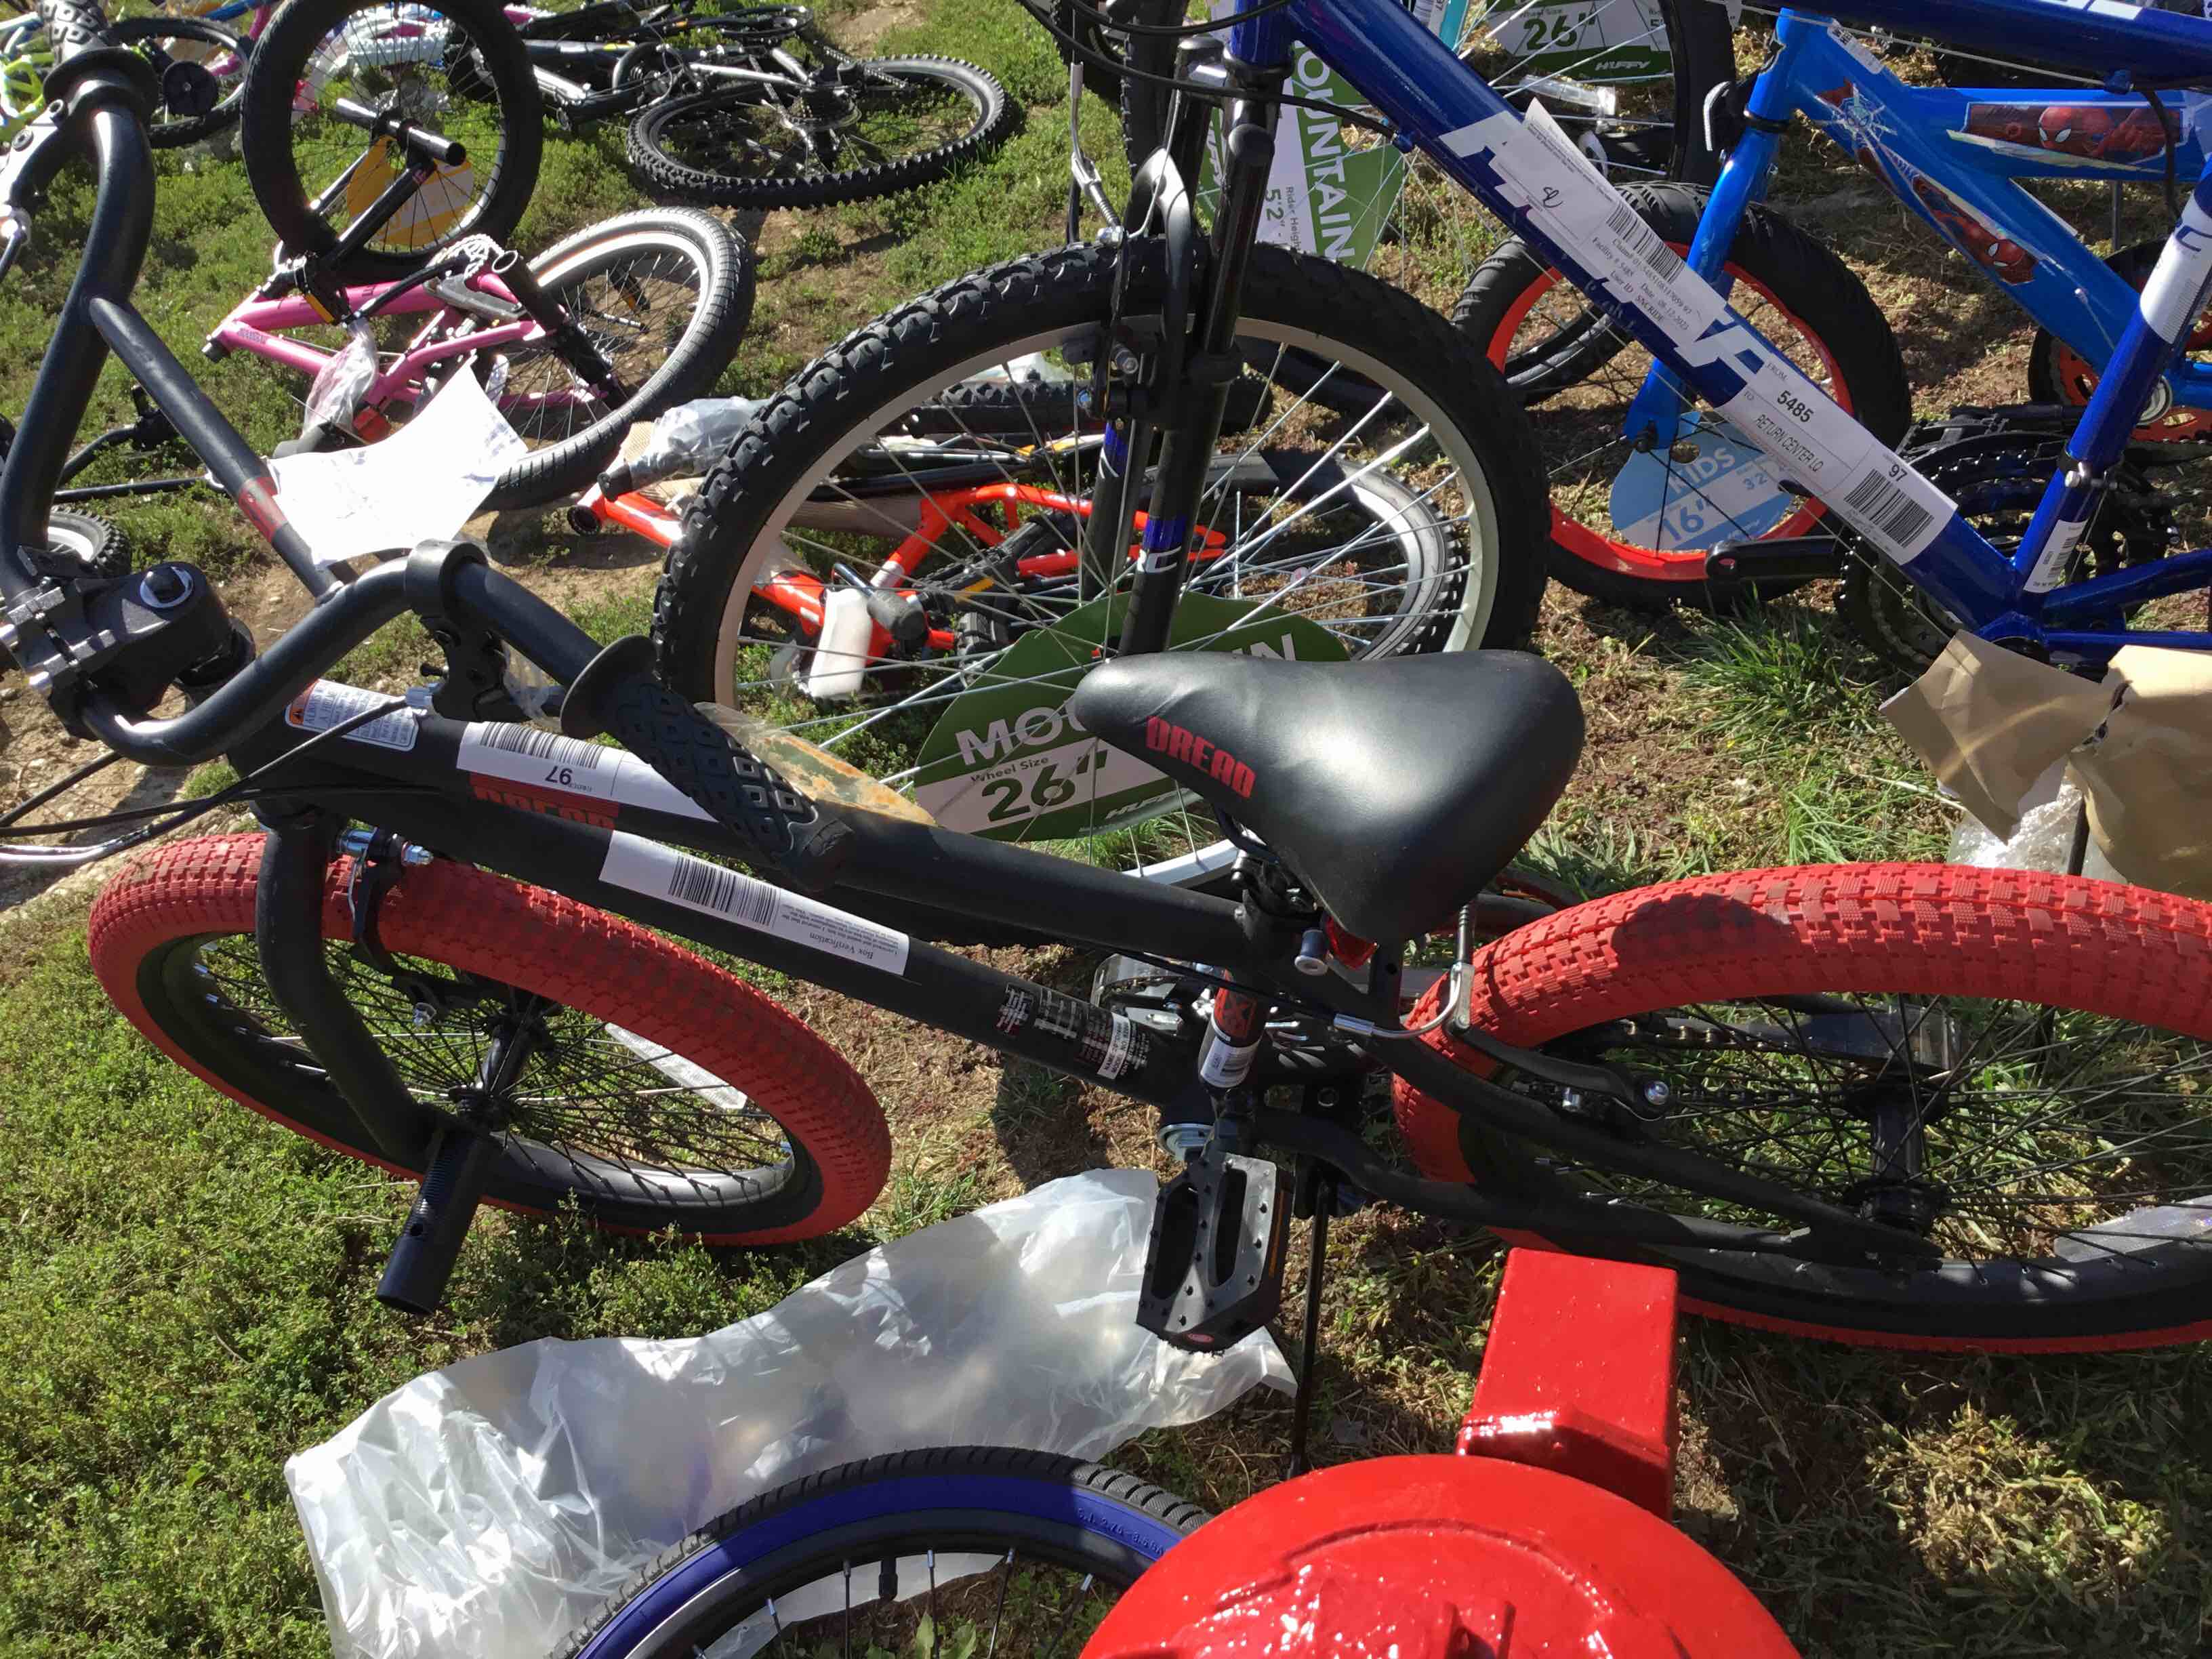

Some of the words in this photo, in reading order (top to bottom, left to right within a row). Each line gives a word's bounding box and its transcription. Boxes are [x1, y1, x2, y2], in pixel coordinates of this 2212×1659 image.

[1523, 12, 1596, 50] 26"
[1595, 60, 1651, 70] HUFFY
[1294, 40, 1355, 260] OUNTAIN
[1286, 186, 1296, 215] Rider
[1777, 390, 1814, 423] 5485
[1754, 414, 1787, 443] RETURN
[1782, 437, 1815, 466] CENTER
[1887, 464, 1908, 483] 97
[970, 764, 1016, 782] Wheel
[1019, 756, 1050, 771] Size
[1145, 716, 1256, 798] DREAD
[545, 766, 573, 785] 97
[981, 750, 1108, 822] 26"
[810, 932, 855, 954] Verification
[857, 947, 874, 960] Box
